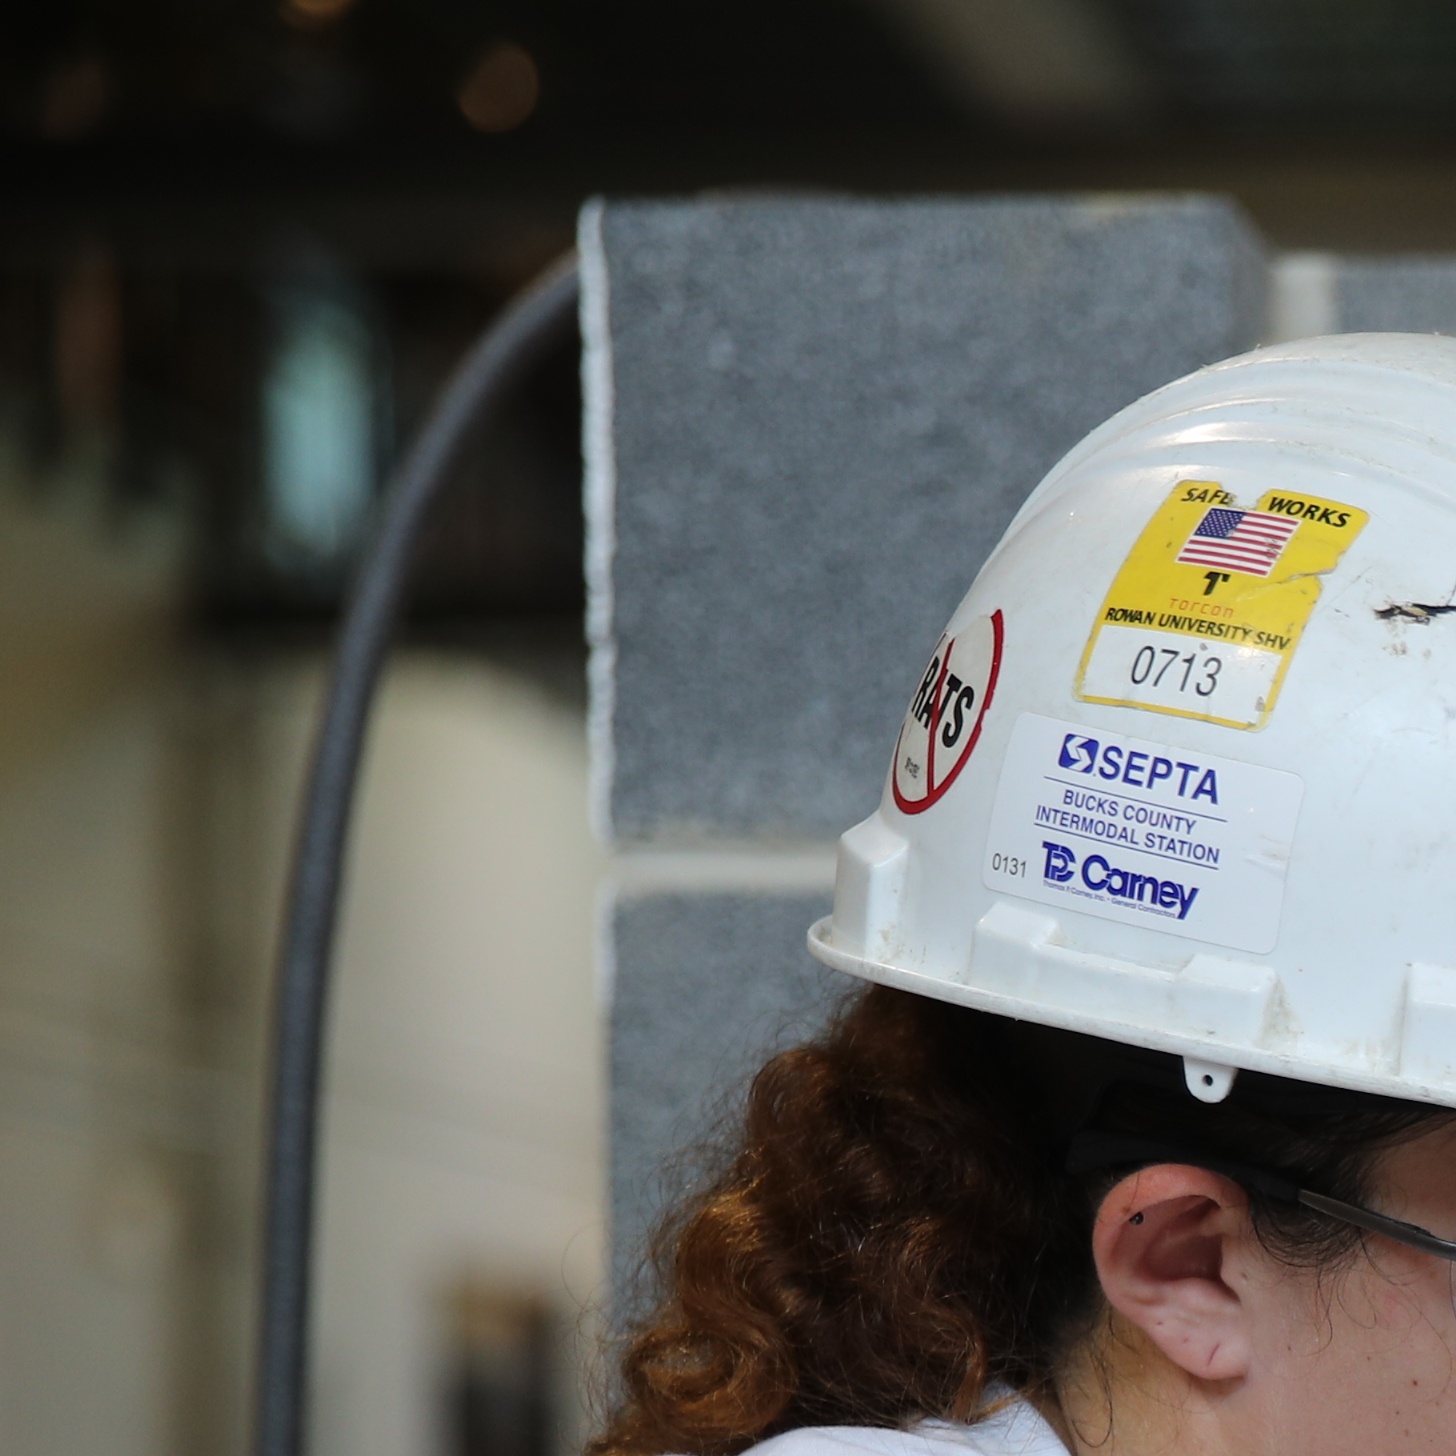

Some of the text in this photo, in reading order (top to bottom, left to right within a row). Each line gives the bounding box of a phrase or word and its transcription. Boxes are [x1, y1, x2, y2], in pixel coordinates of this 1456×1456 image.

[1266, 497, 1352, 529] WORKS
[1104, 607, 1292, 651] ROWAN UNIVERSITY SHV
[1130, 645, 1222, 698] 0713
[1098, 745, 1219, 805] SEPTA
[1036, 804, 1220, 864] INTERMODAL STATION
[1063, 789, 1197, 835] BUCKS COUNTY
[992, 852, 1027, 879] 0131
[1081, 853, 1200, 920] Carney
